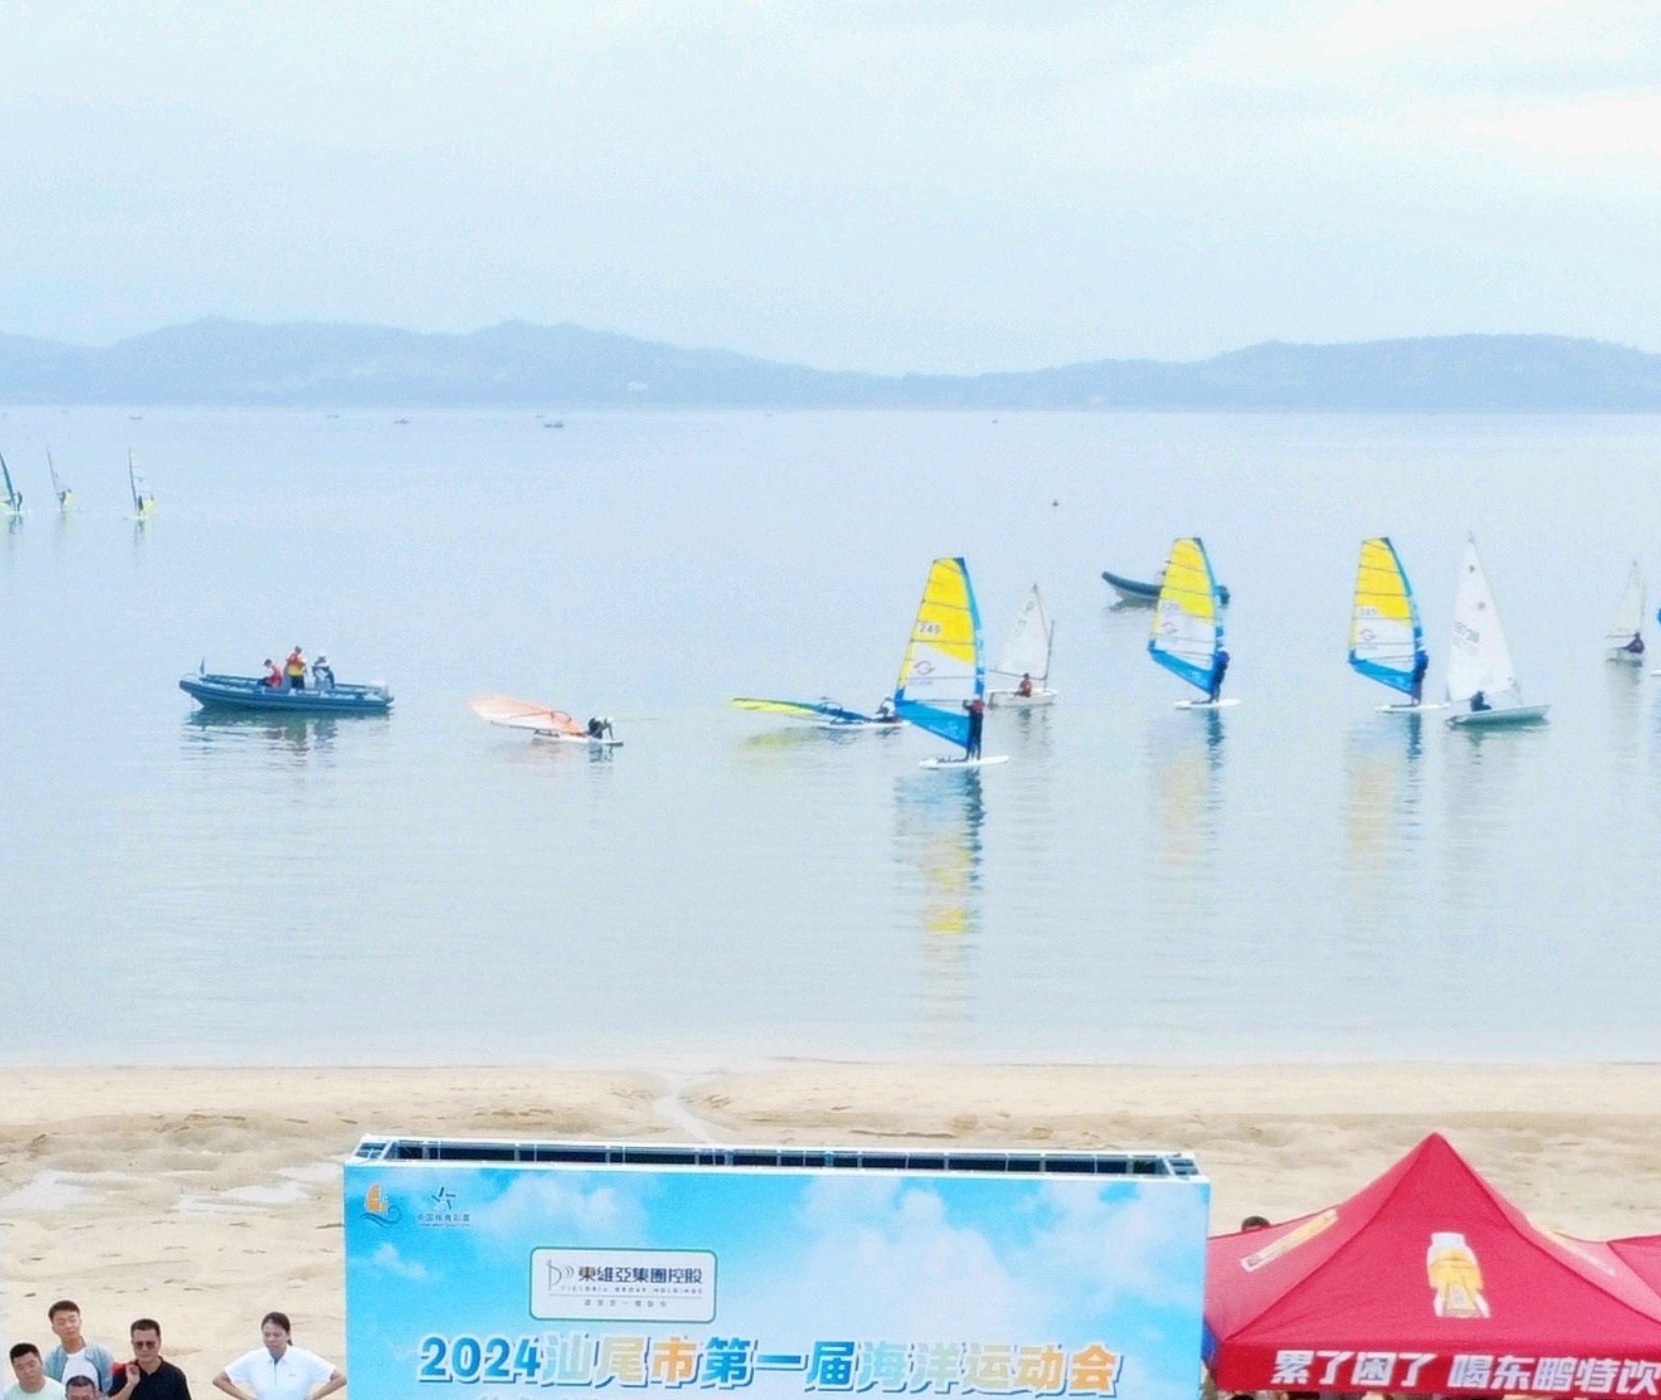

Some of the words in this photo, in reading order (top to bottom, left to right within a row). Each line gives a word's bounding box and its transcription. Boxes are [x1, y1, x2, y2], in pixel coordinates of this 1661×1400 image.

[420, 1333, 1120, 1395] 2024汕尾市第一届海洋运动会
[1270, 1350, 1438, 1386] 累了困了
